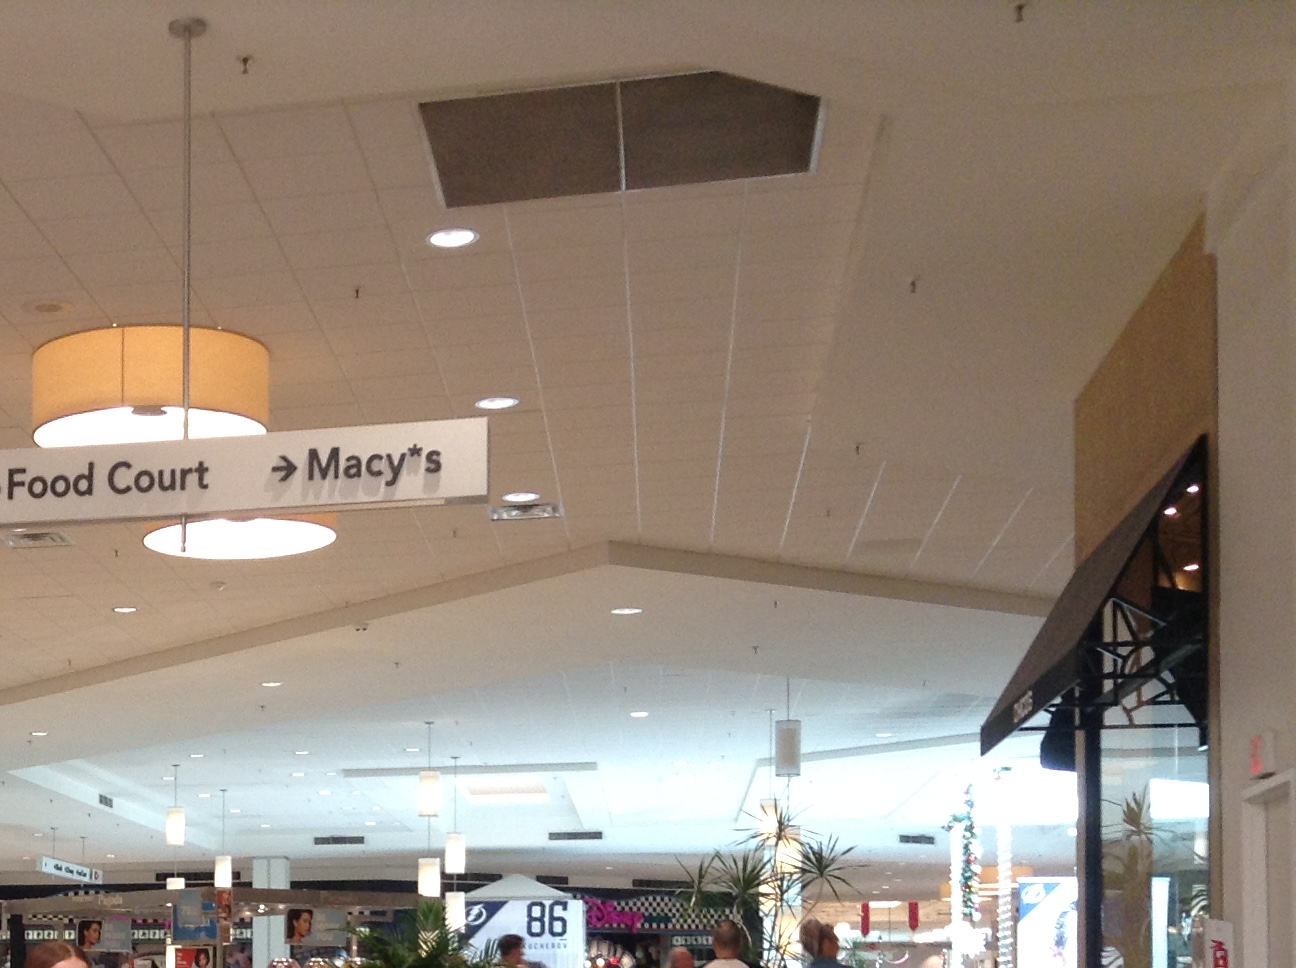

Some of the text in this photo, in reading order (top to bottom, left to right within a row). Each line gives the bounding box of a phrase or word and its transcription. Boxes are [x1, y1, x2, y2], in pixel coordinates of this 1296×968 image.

[6, 459, 210, 500] Food Court
[526, 901, 568, 937] 86
